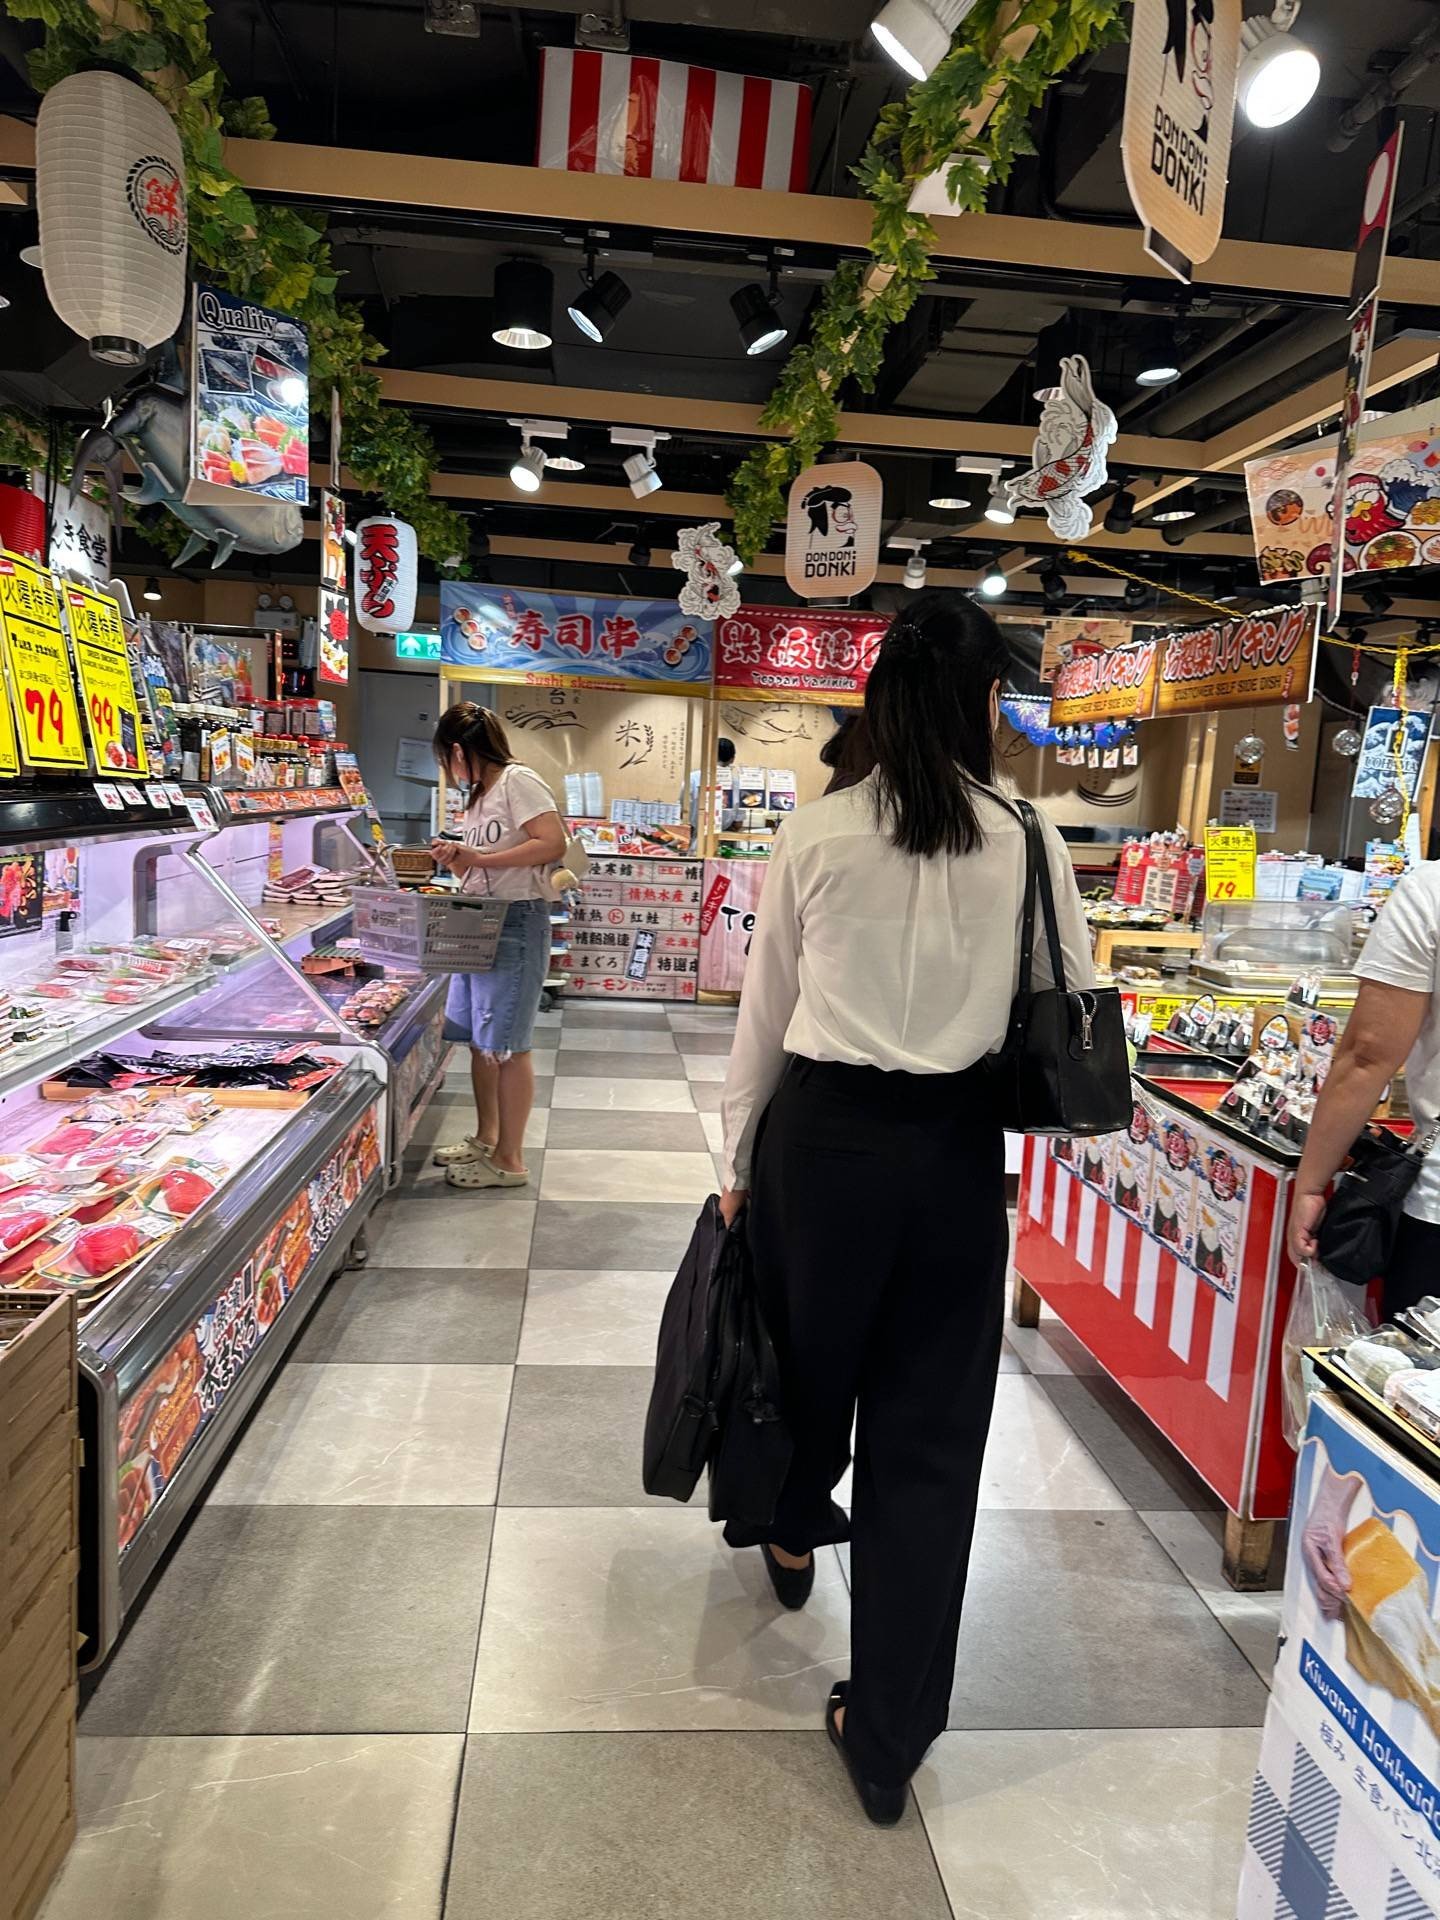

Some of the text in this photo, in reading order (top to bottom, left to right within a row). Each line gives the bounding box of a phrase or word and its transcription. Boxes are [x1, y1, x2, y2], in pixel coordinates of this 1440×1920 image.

[1151, 132, 1207, 216] DONKI
[200, 292, 278, 338] Quality
[804, 561, 856, 578] DONKI
[4, 574, 58, 619] 火曜特売
[75, 605, 122, 644] 火曜特売
[509, 608, 641, 660] 寿司串
[525, 672, 564, 688] Sushi
[751, 671, 800, 687] Teppan
[25, 687, 64, 745] 79
[91, 693, 115, 736] 99
[615, 720, 641, 748] 米
[1210, 836, 1253, 847] 火曜特売
[628, 887, 685, 903] 情熱水産
[1213, 881, 1236, 898] 19
[580, 955, 618, 969] まぐろ
[573, 977, 629, 991] サーモン
[1303, 1652, 1359, 1730] Kiwami
